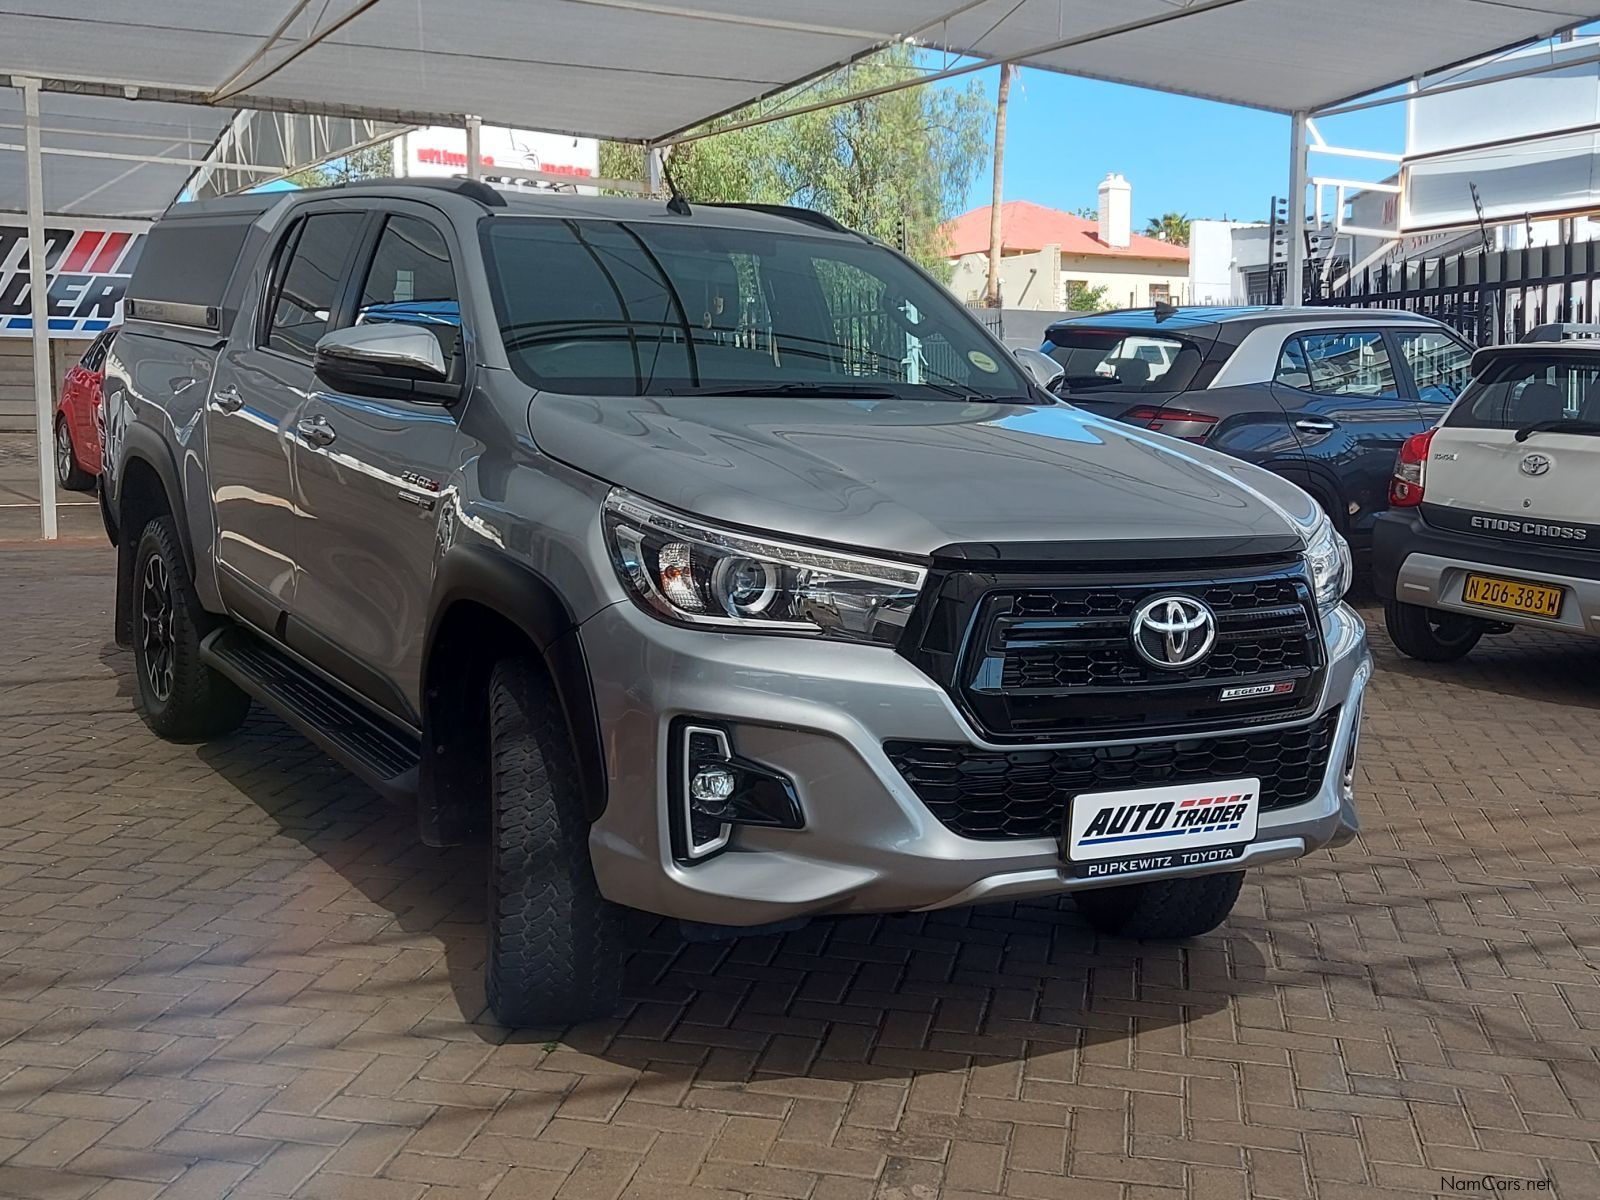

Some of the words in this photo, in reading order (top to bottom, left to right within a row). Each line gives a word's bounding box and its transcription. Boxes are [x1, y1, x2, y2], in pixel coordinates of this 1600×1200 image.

[1471, 516, 1520, 532] ETIOS
[1522, 523, 1587, 540] CROSS
[1469, 579, 1480, 599] N
[1481, 582, 1545, 609] 206-383
[1547, 592, 1559, 613] W
[1227, 686, 1271, 696] LEGEND
[1082, 801, 1175, 838] AUTO
[1172, 803, 1248, 828] TRADER
[1088, 856, 1172, 876] PUPKEWITZ
[1181, 848, 1234, 864] TOYOTA
